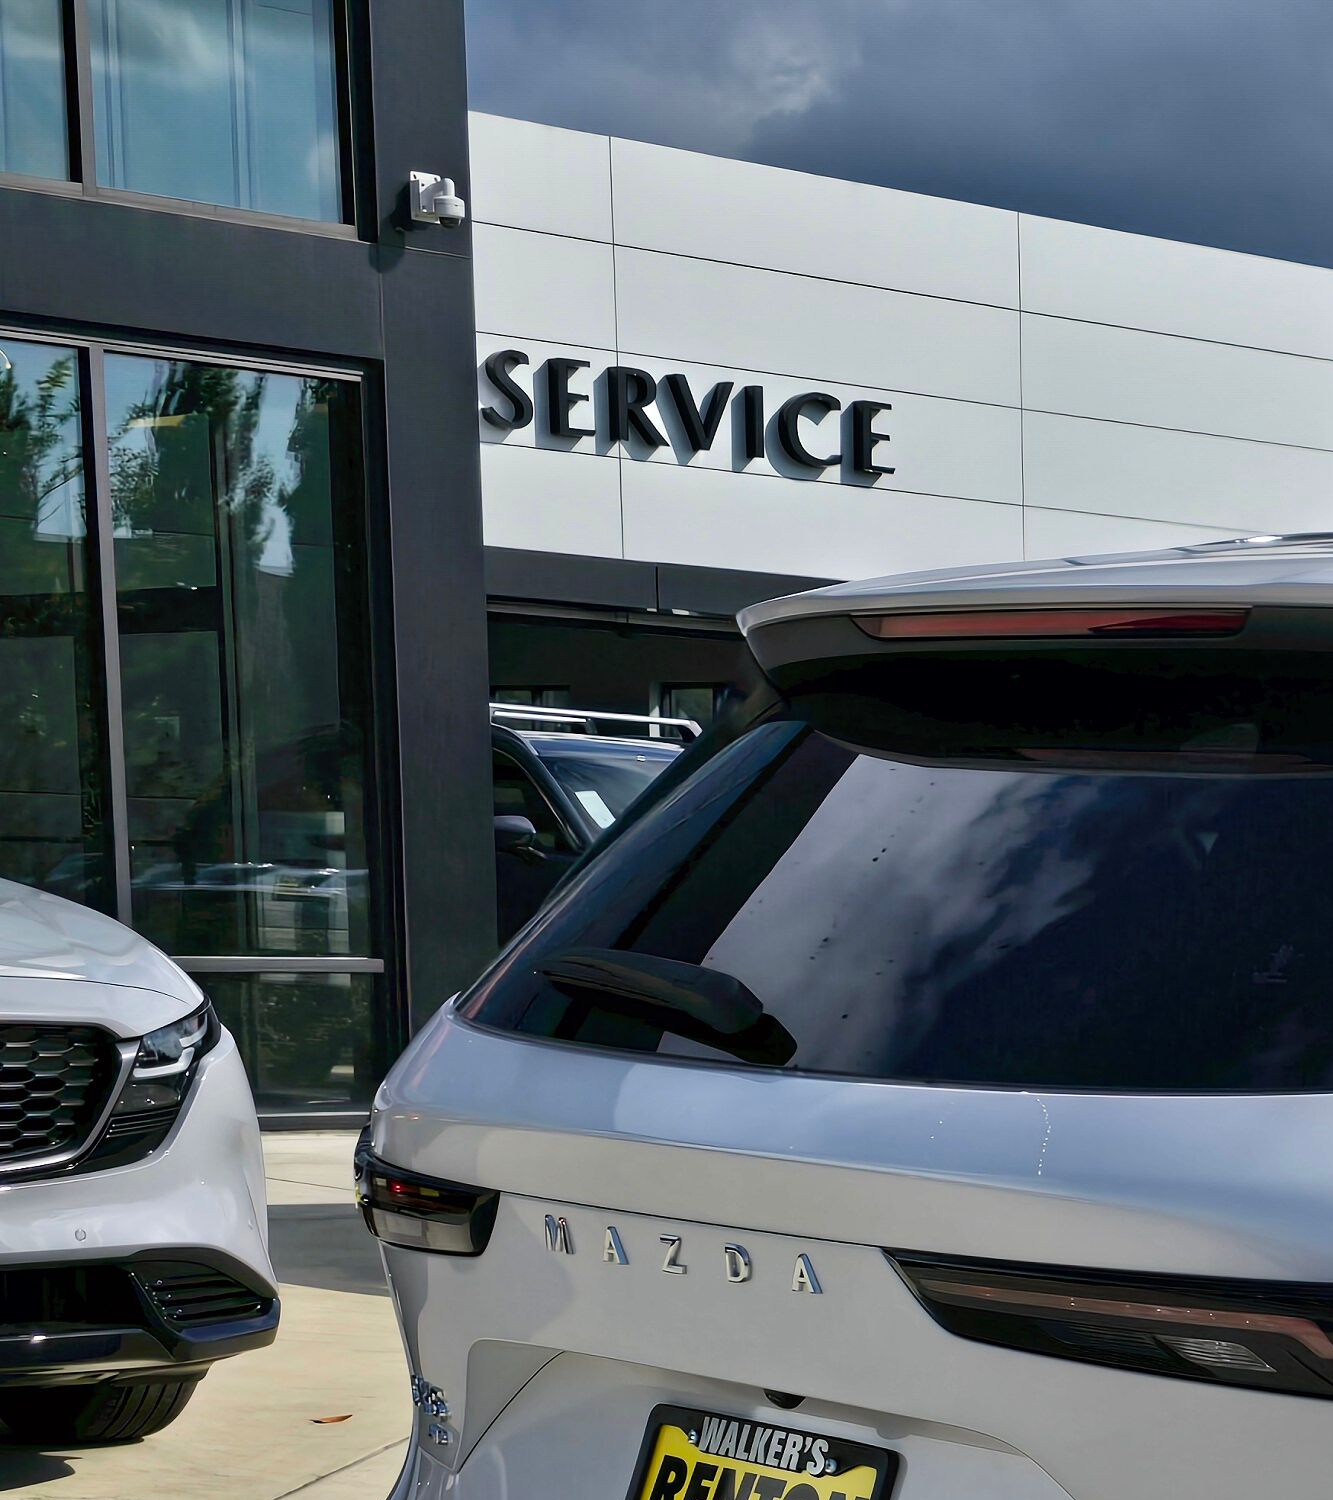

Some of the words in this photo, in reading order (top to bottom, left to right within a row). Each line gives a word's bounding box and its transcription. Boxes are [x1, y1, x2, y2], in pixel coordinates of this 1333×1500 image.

[480, 349, 895, 474] SERVICE
[544, 1213, 824, 1295] MAZDA
[699, 1416, 829, 1476] WALKER'S
